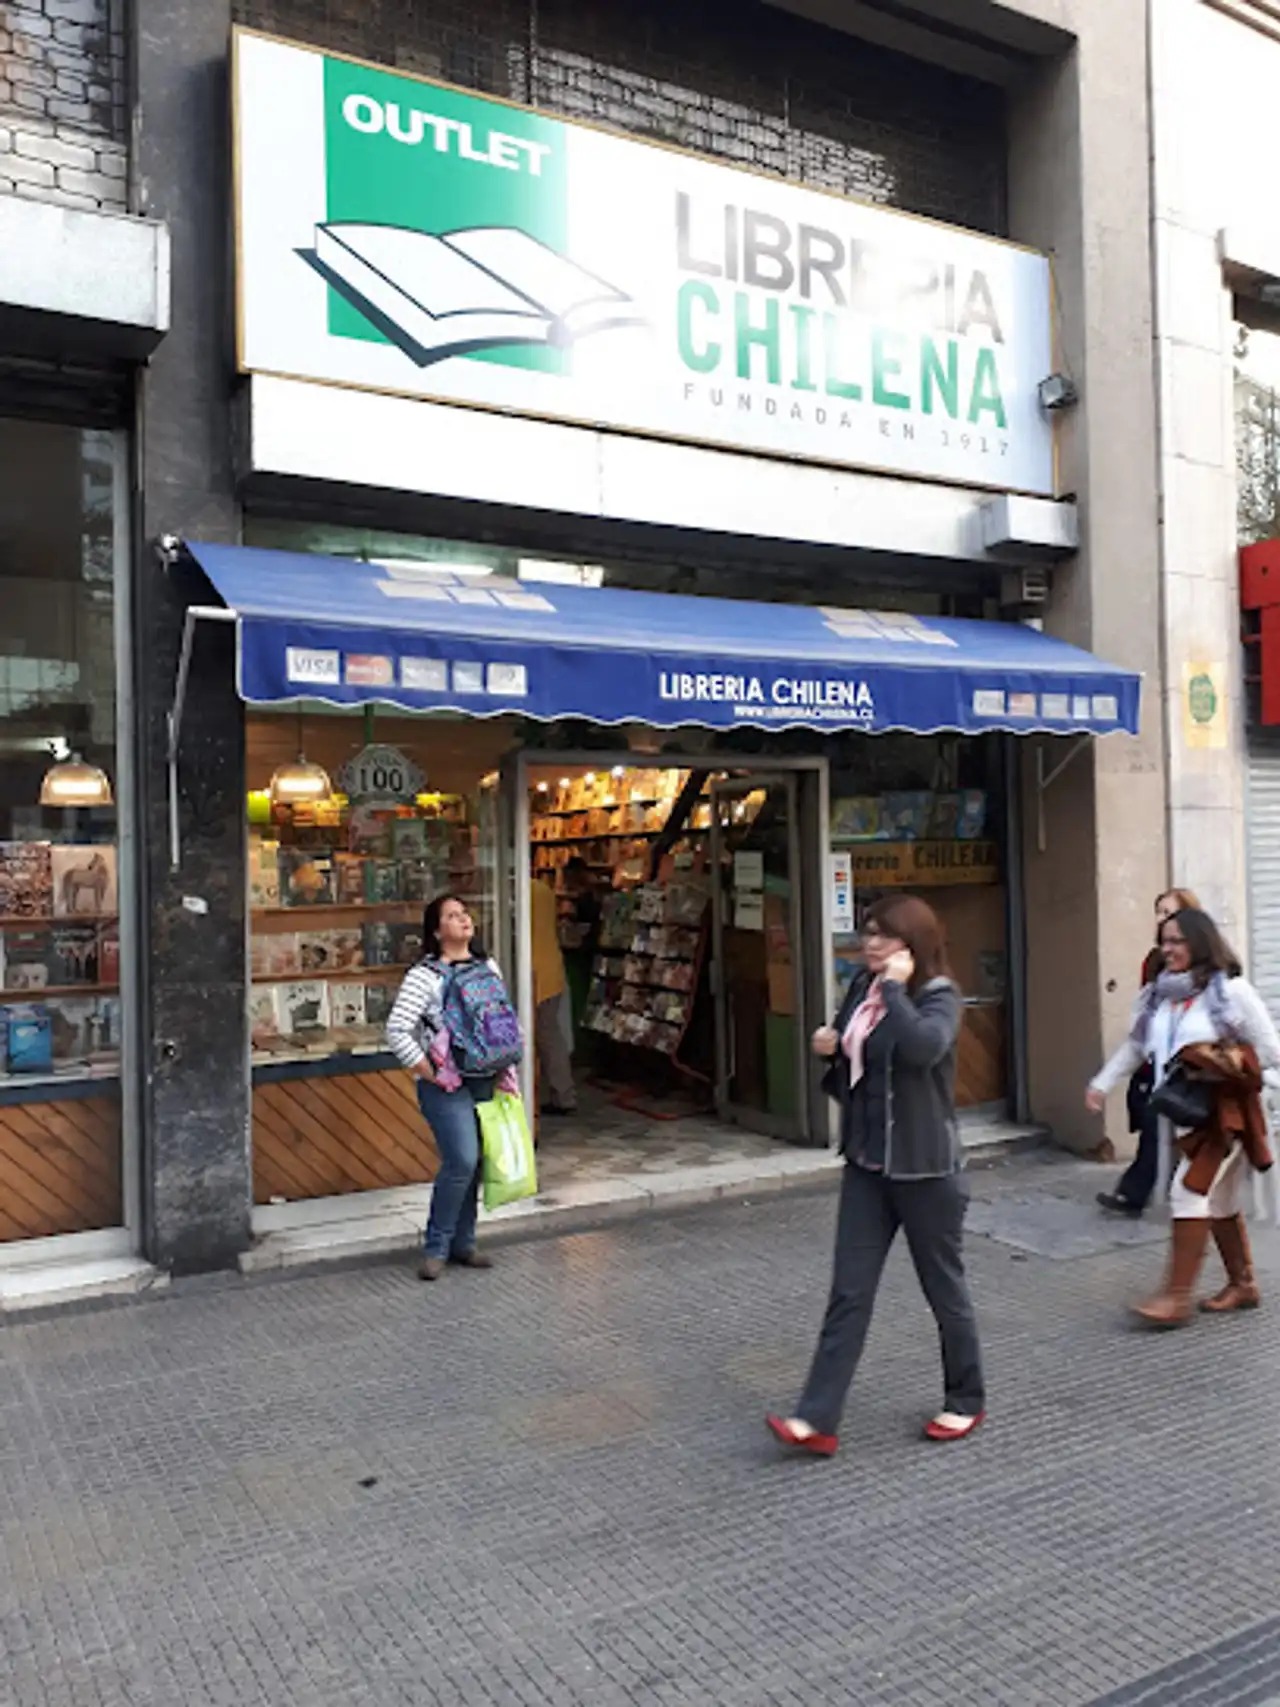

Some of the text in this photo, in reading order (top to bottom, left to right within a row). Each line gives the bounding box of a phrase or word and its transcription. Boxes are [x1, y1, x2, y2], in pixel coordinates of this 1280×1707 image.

[342, 94, 551, 177] OUTLET
[677, 279, 1007, 429] CHILENA
[684, 382, 1009, 456] FUNDADA EN 1917
[293, 656, 336, 674] VISA
[660, 671, 874, 706] LIBRERIA CHILENA
